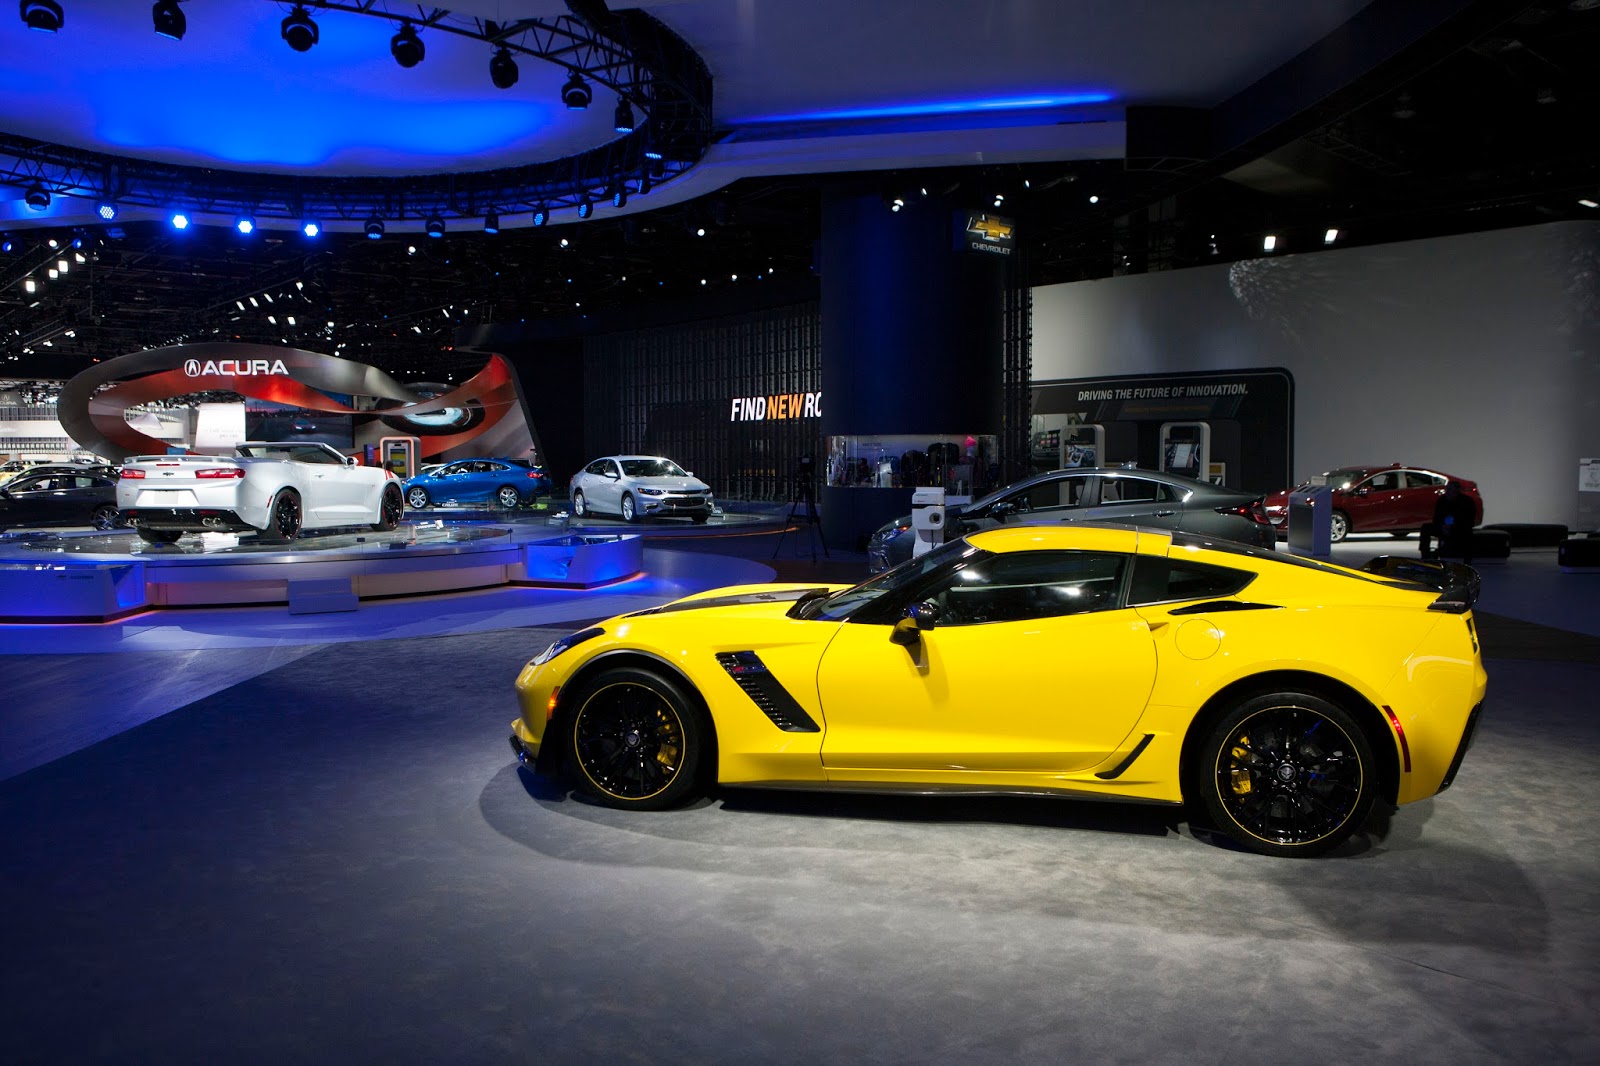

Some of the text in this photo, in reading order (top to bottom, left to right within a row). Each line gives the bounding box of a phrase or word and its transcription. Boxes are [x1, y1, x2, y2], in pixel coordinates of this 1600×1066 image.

[972, 242, 1011, 255] CHEVROLET
[201, 359, 289, 376] ACURA
[1078, 383, 1248, 401] DRIVING THE FUTURE OF INNOVATION.
[731, 396, 766, 422] FIND
[767, 393, 804, 420] NEW
